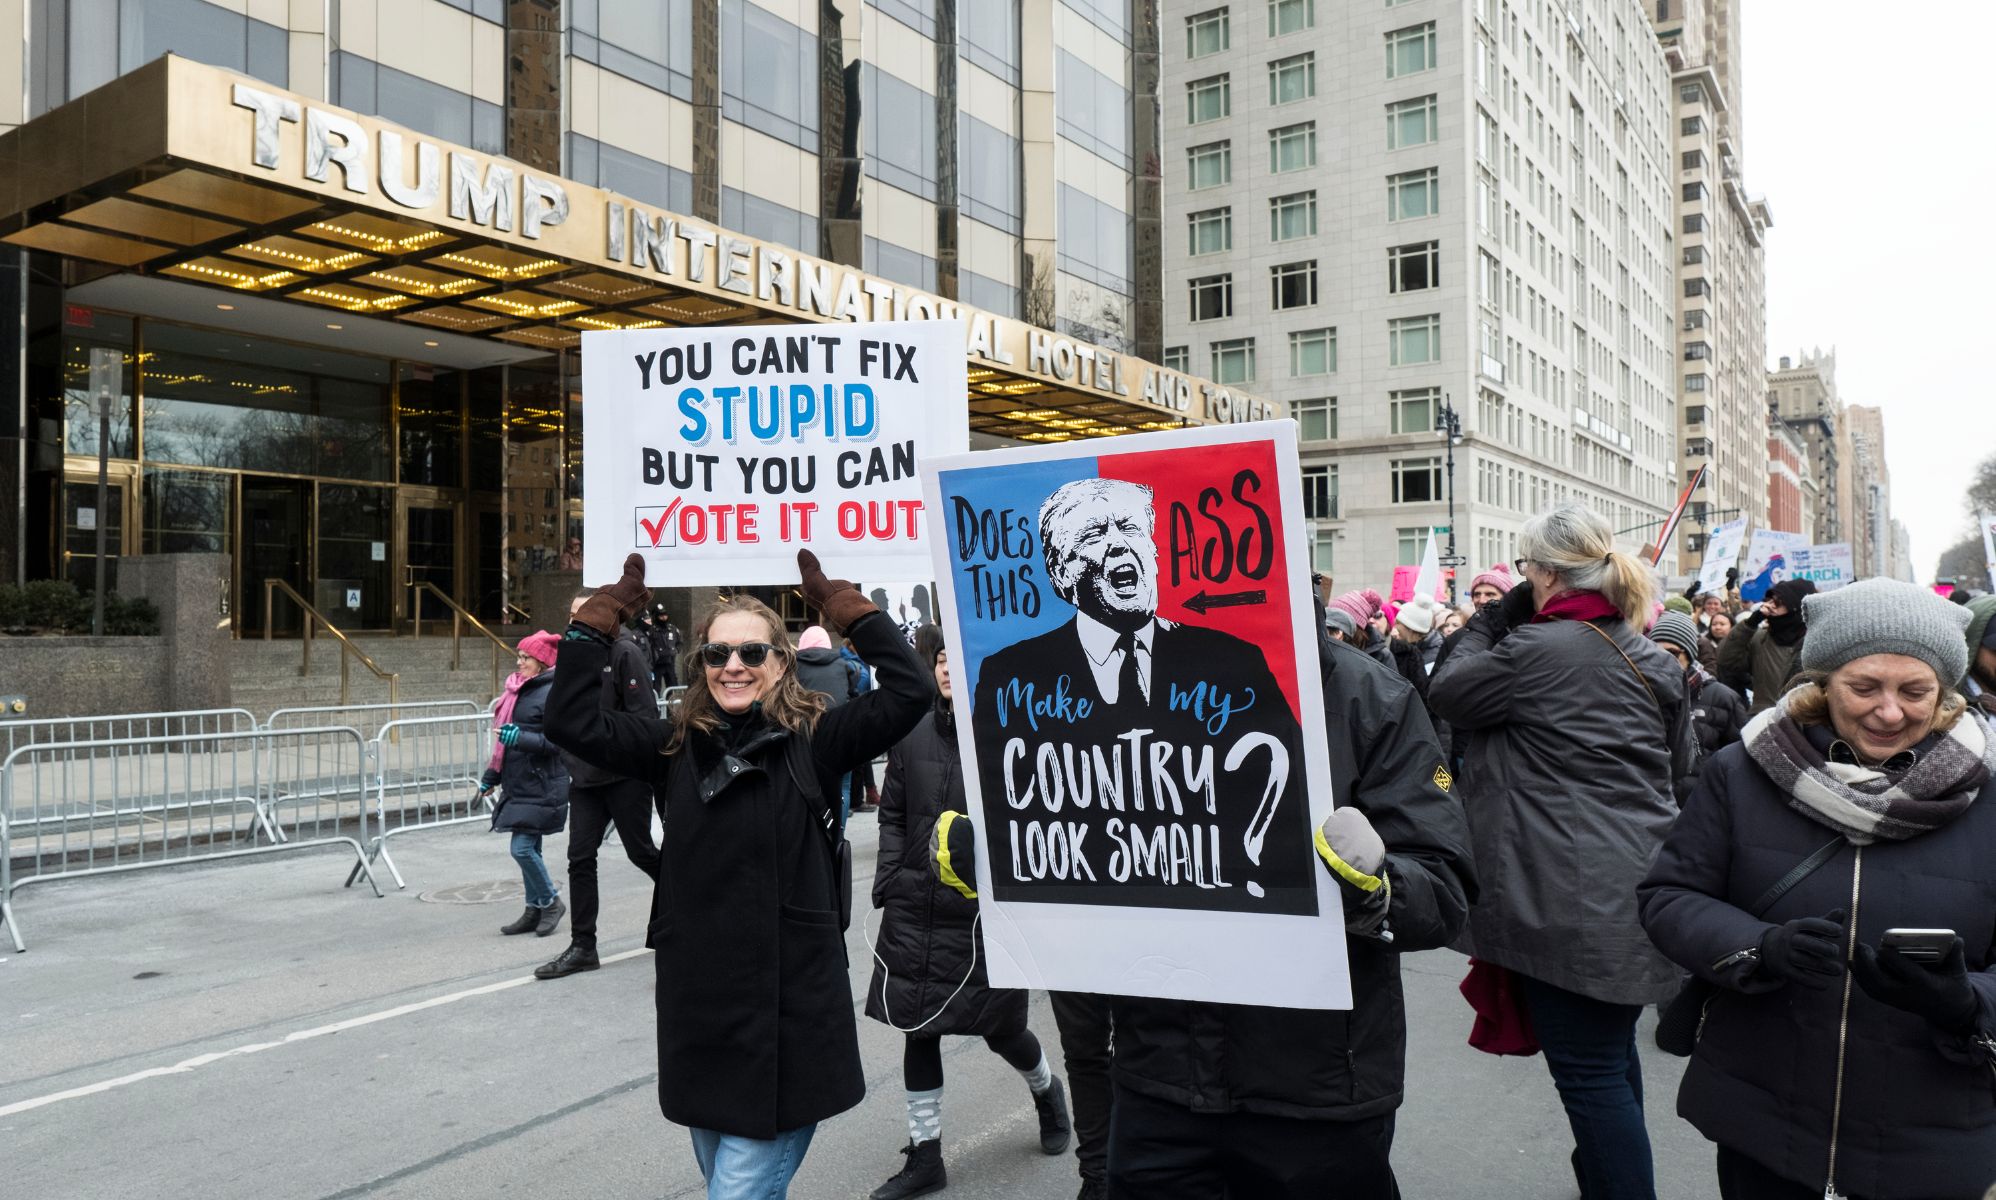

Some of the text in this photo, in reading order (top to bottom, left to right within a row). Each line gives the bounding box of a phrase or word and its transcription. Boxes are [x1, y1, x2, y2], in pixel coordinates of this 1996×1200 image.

[232, 83, 570, 239] TRUMP
[1027, 330, 1128, 397] HOTEL
[1139, 367, 1192, 411] AND
[634, 335, 919, 389] YOU CAN'T FIX
[677, 384, 879, 447] STUPID
[642, 440, 915, 494] BUT YOU CAN
[779, 502, 818, 543] IT
[837, 500, 925, 543] OUT
[950, 495, 1034, 562] DOES
[1170, 468, 1274, 587] ASS
[349, 592, 358, 602] A
[964, 563, 1041, 621] THIS
[1791, 568, 1841, 580] MARCH
[996, 674, 1093, 732] Make
[1003, 728, 1216, 815] COUNTRY
[1009, 820, 1097, 881] LOOK
